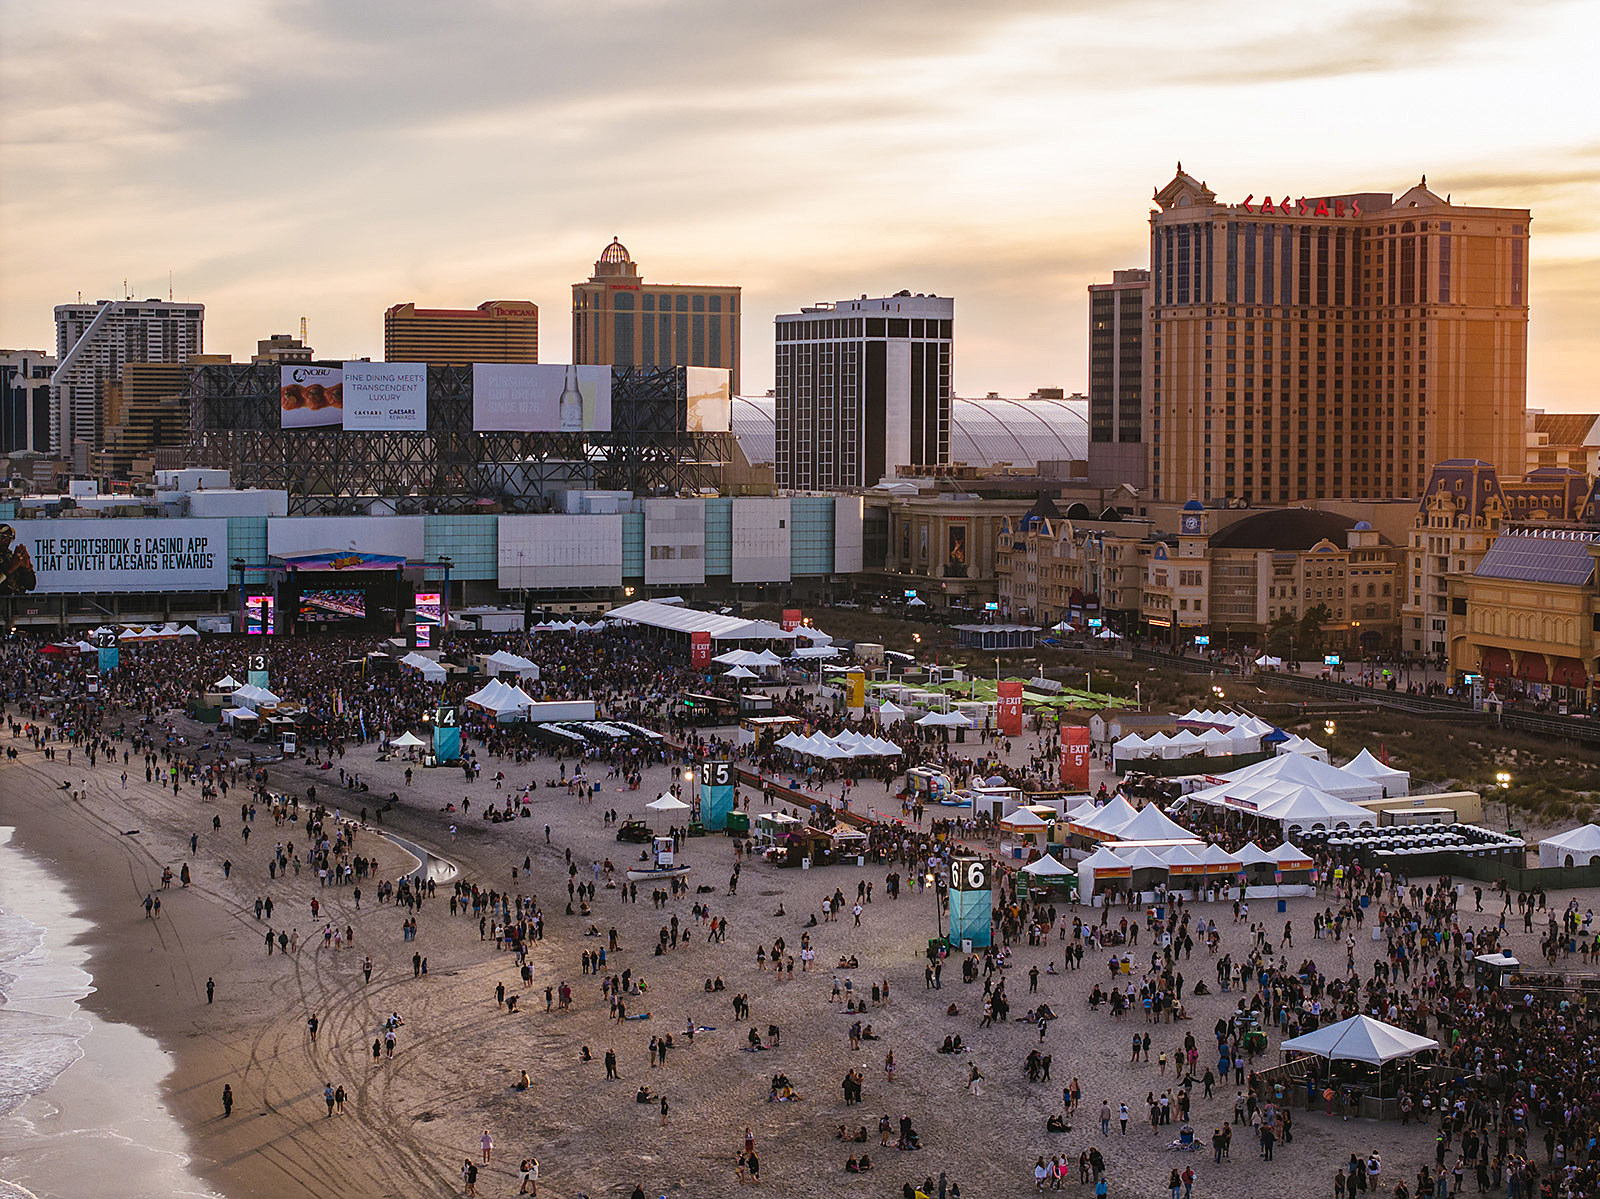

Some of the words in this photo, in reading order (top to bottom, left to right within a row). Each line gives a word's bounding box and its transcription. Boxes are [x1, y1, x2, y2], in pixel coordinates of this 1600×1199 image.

[1243, 194, 1361, 217] CAESARS
[496, 307, 535, 316] TROPICANA
[303, 368, 331, 376] NOBU
[35, 539, 56, 555] THE
[60, 538, 130, 555] SPORTSBOOK
[134, 538, 141, 554] &
[145, 537, 183, 554] CASINO
[187, 537, 208, 553] APP
[35, 555, 63, 571] THAT
[67, 554, 105, 571] GIVETH
[109, 554, 158, 570] CAESARS
[162, 553, 213, 570] REWARDS
[107, 635, 116, 647] 2
[700, 650, 706, 659] 3
[255, 656, 264, 670] 3
[1006, 697, 1021, 705] EXIT
[1010, 705, 1017, 716] 4
[443, 709, 456, 726] 4
[1070, 744, 1088, 753] EXIT
[1075, 755, 1083, 766] 5
[716, 764, 729, 784] 5
[951, 861, 959, 887] 6
[968, 862, 985, 888] 6
